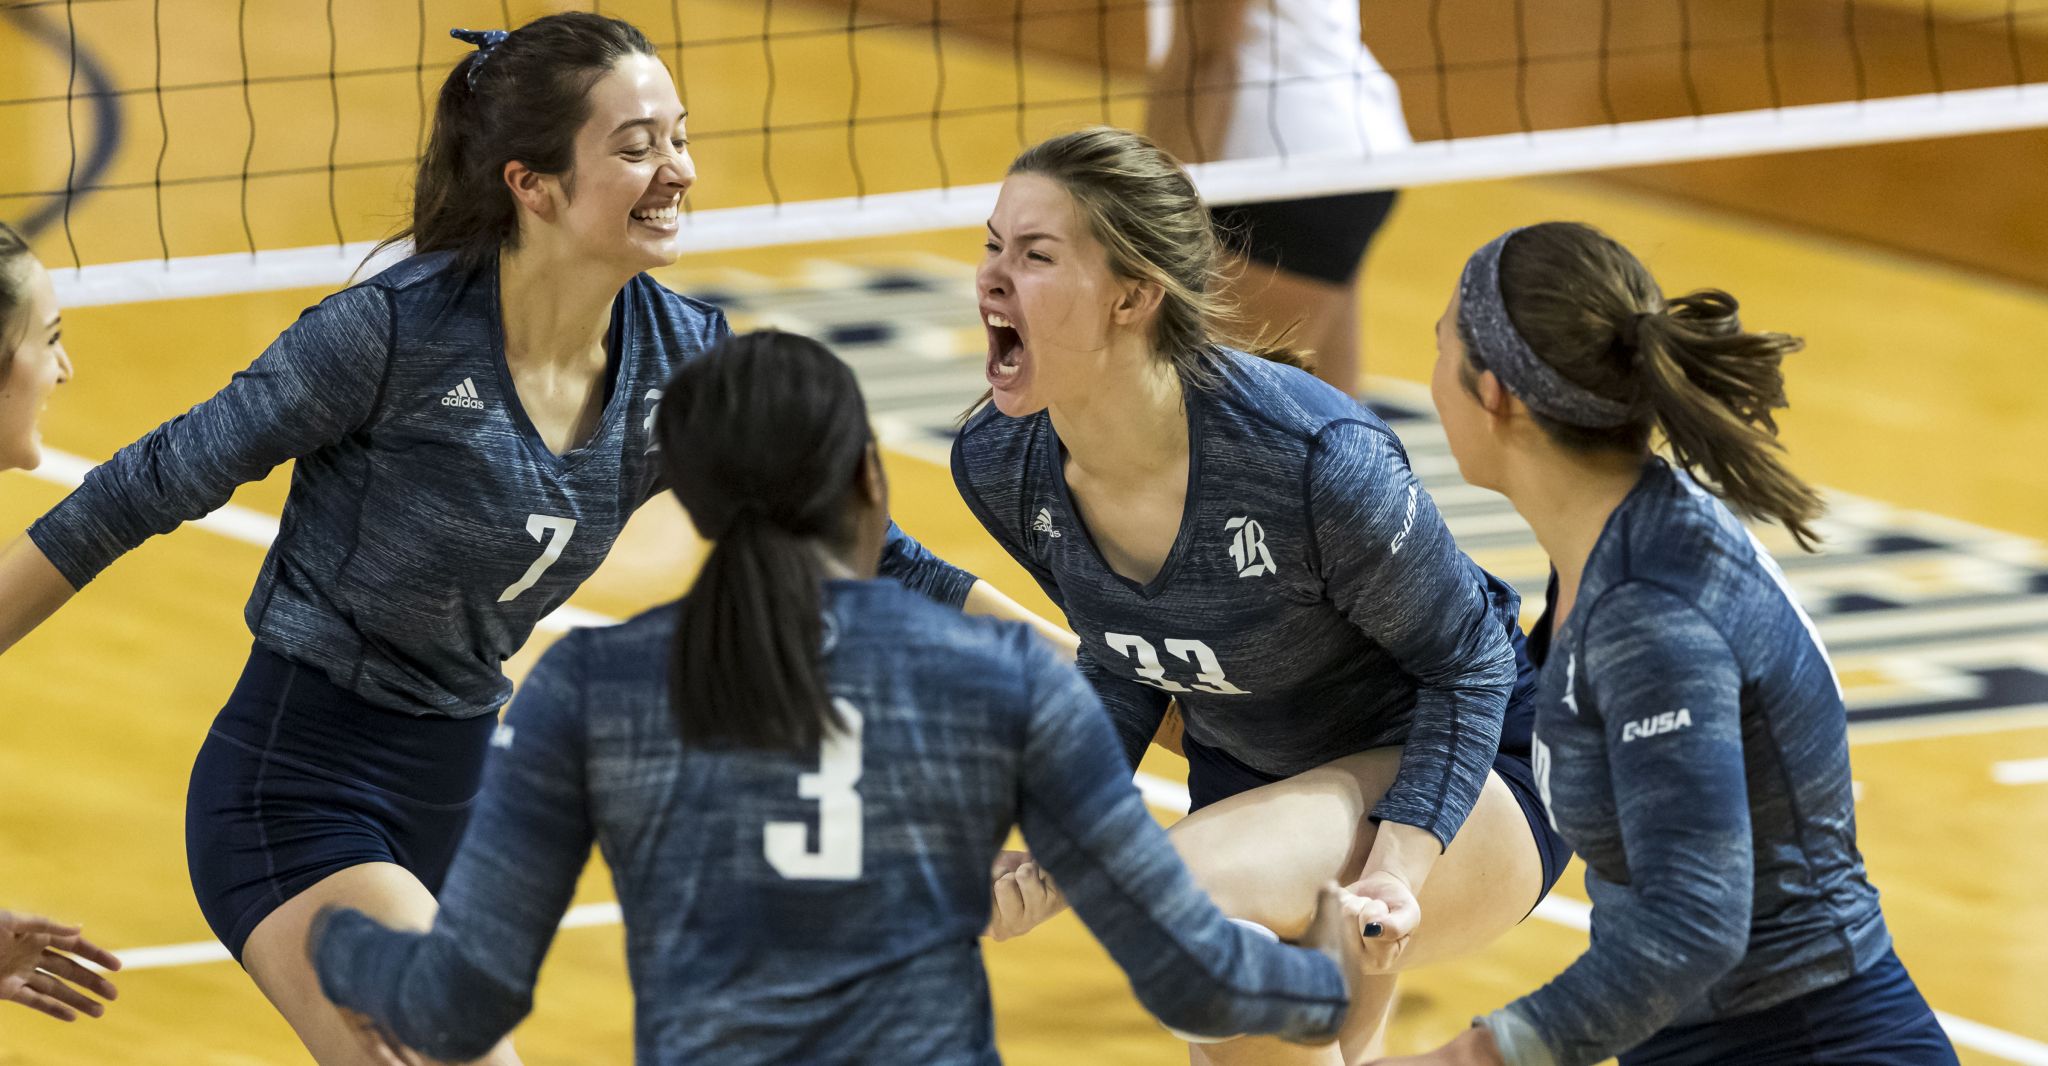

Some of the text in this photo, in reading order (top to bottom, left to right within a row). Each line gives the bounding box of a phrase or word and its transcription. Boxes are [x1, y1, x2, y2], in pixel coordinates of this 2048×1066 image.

[441, 394, 484, 410] adidas
[497, 513, 577, 602] 7
[1104, 632, 1252, 694] 33
[763, 696, 863, 880] 3
